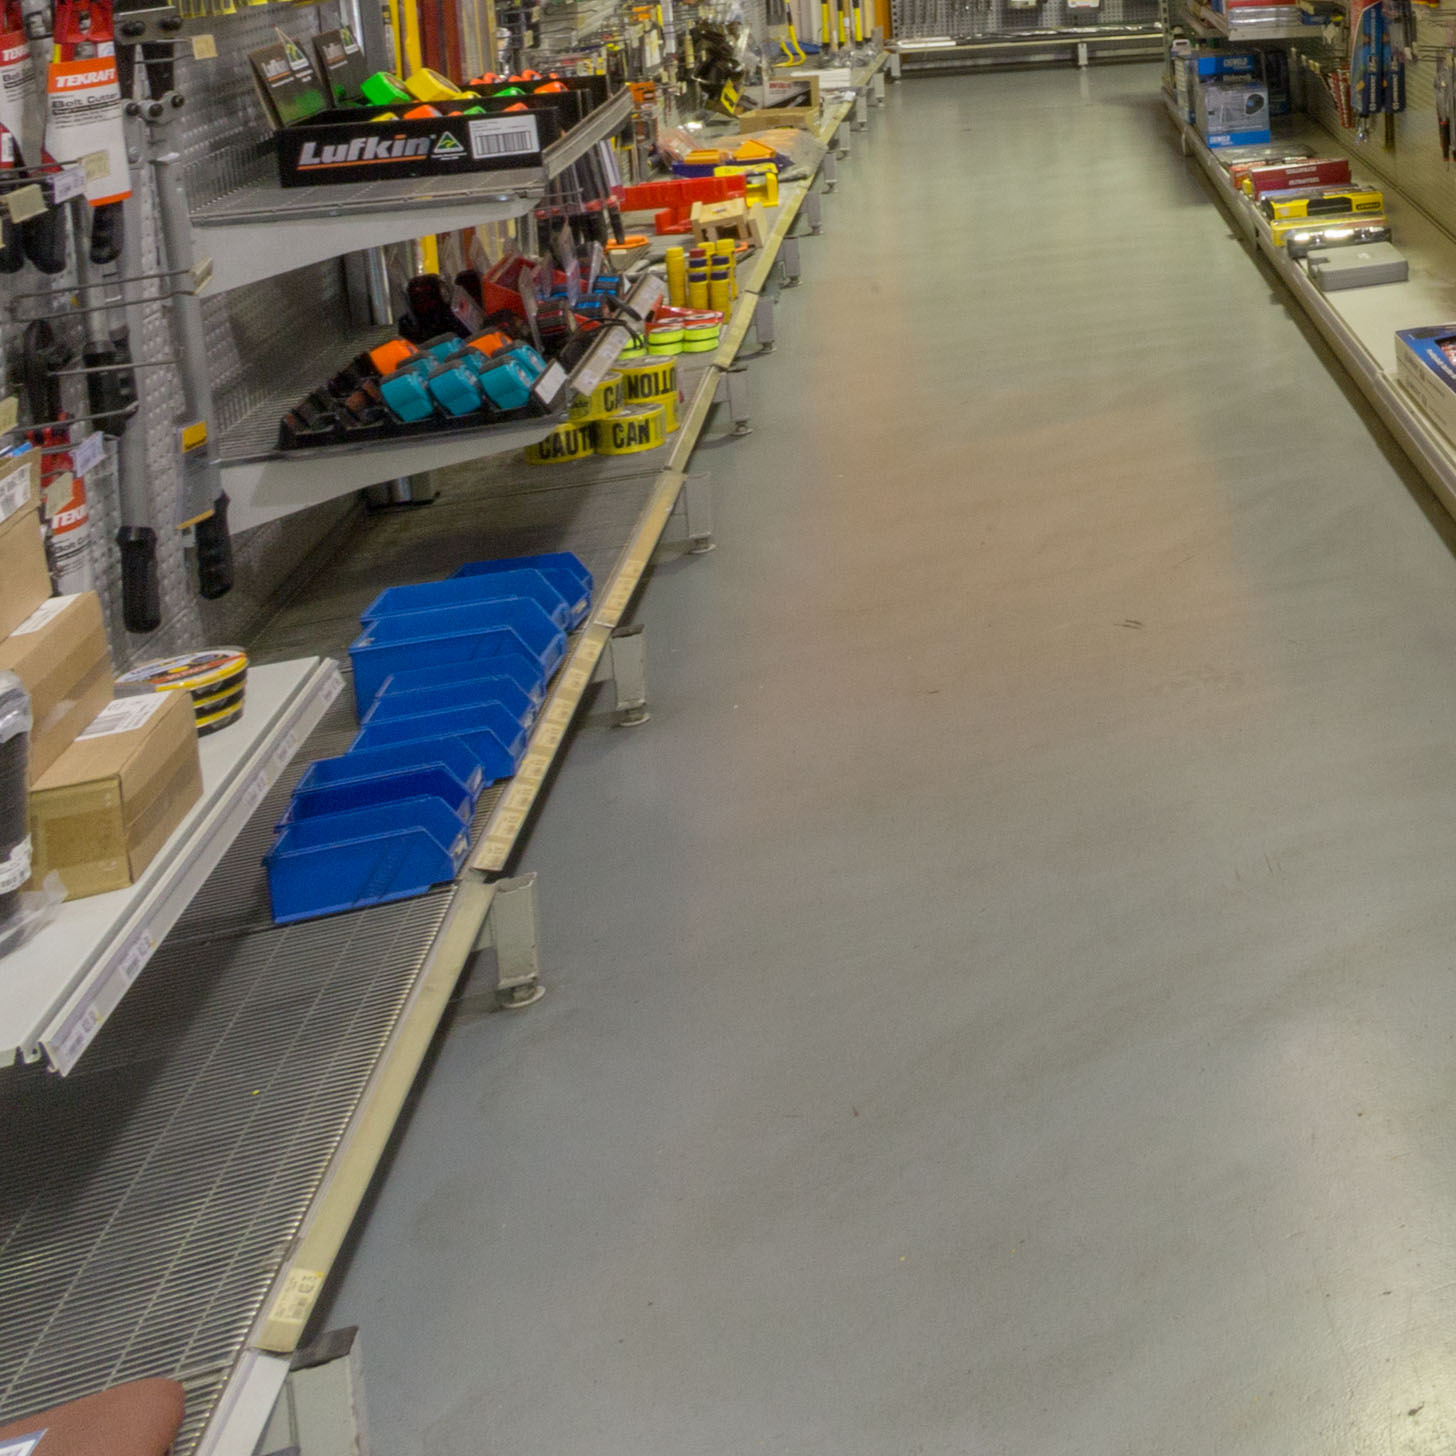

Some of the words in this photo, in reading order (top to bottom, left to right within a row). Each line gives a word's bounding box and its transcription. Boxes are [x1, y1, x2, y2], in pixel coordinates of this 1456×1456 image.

[56, 68, 115, 88] TEKRAFT
[52, 98, 83, 109] Bolt
[299, 134, 431, 166] Lufkin
